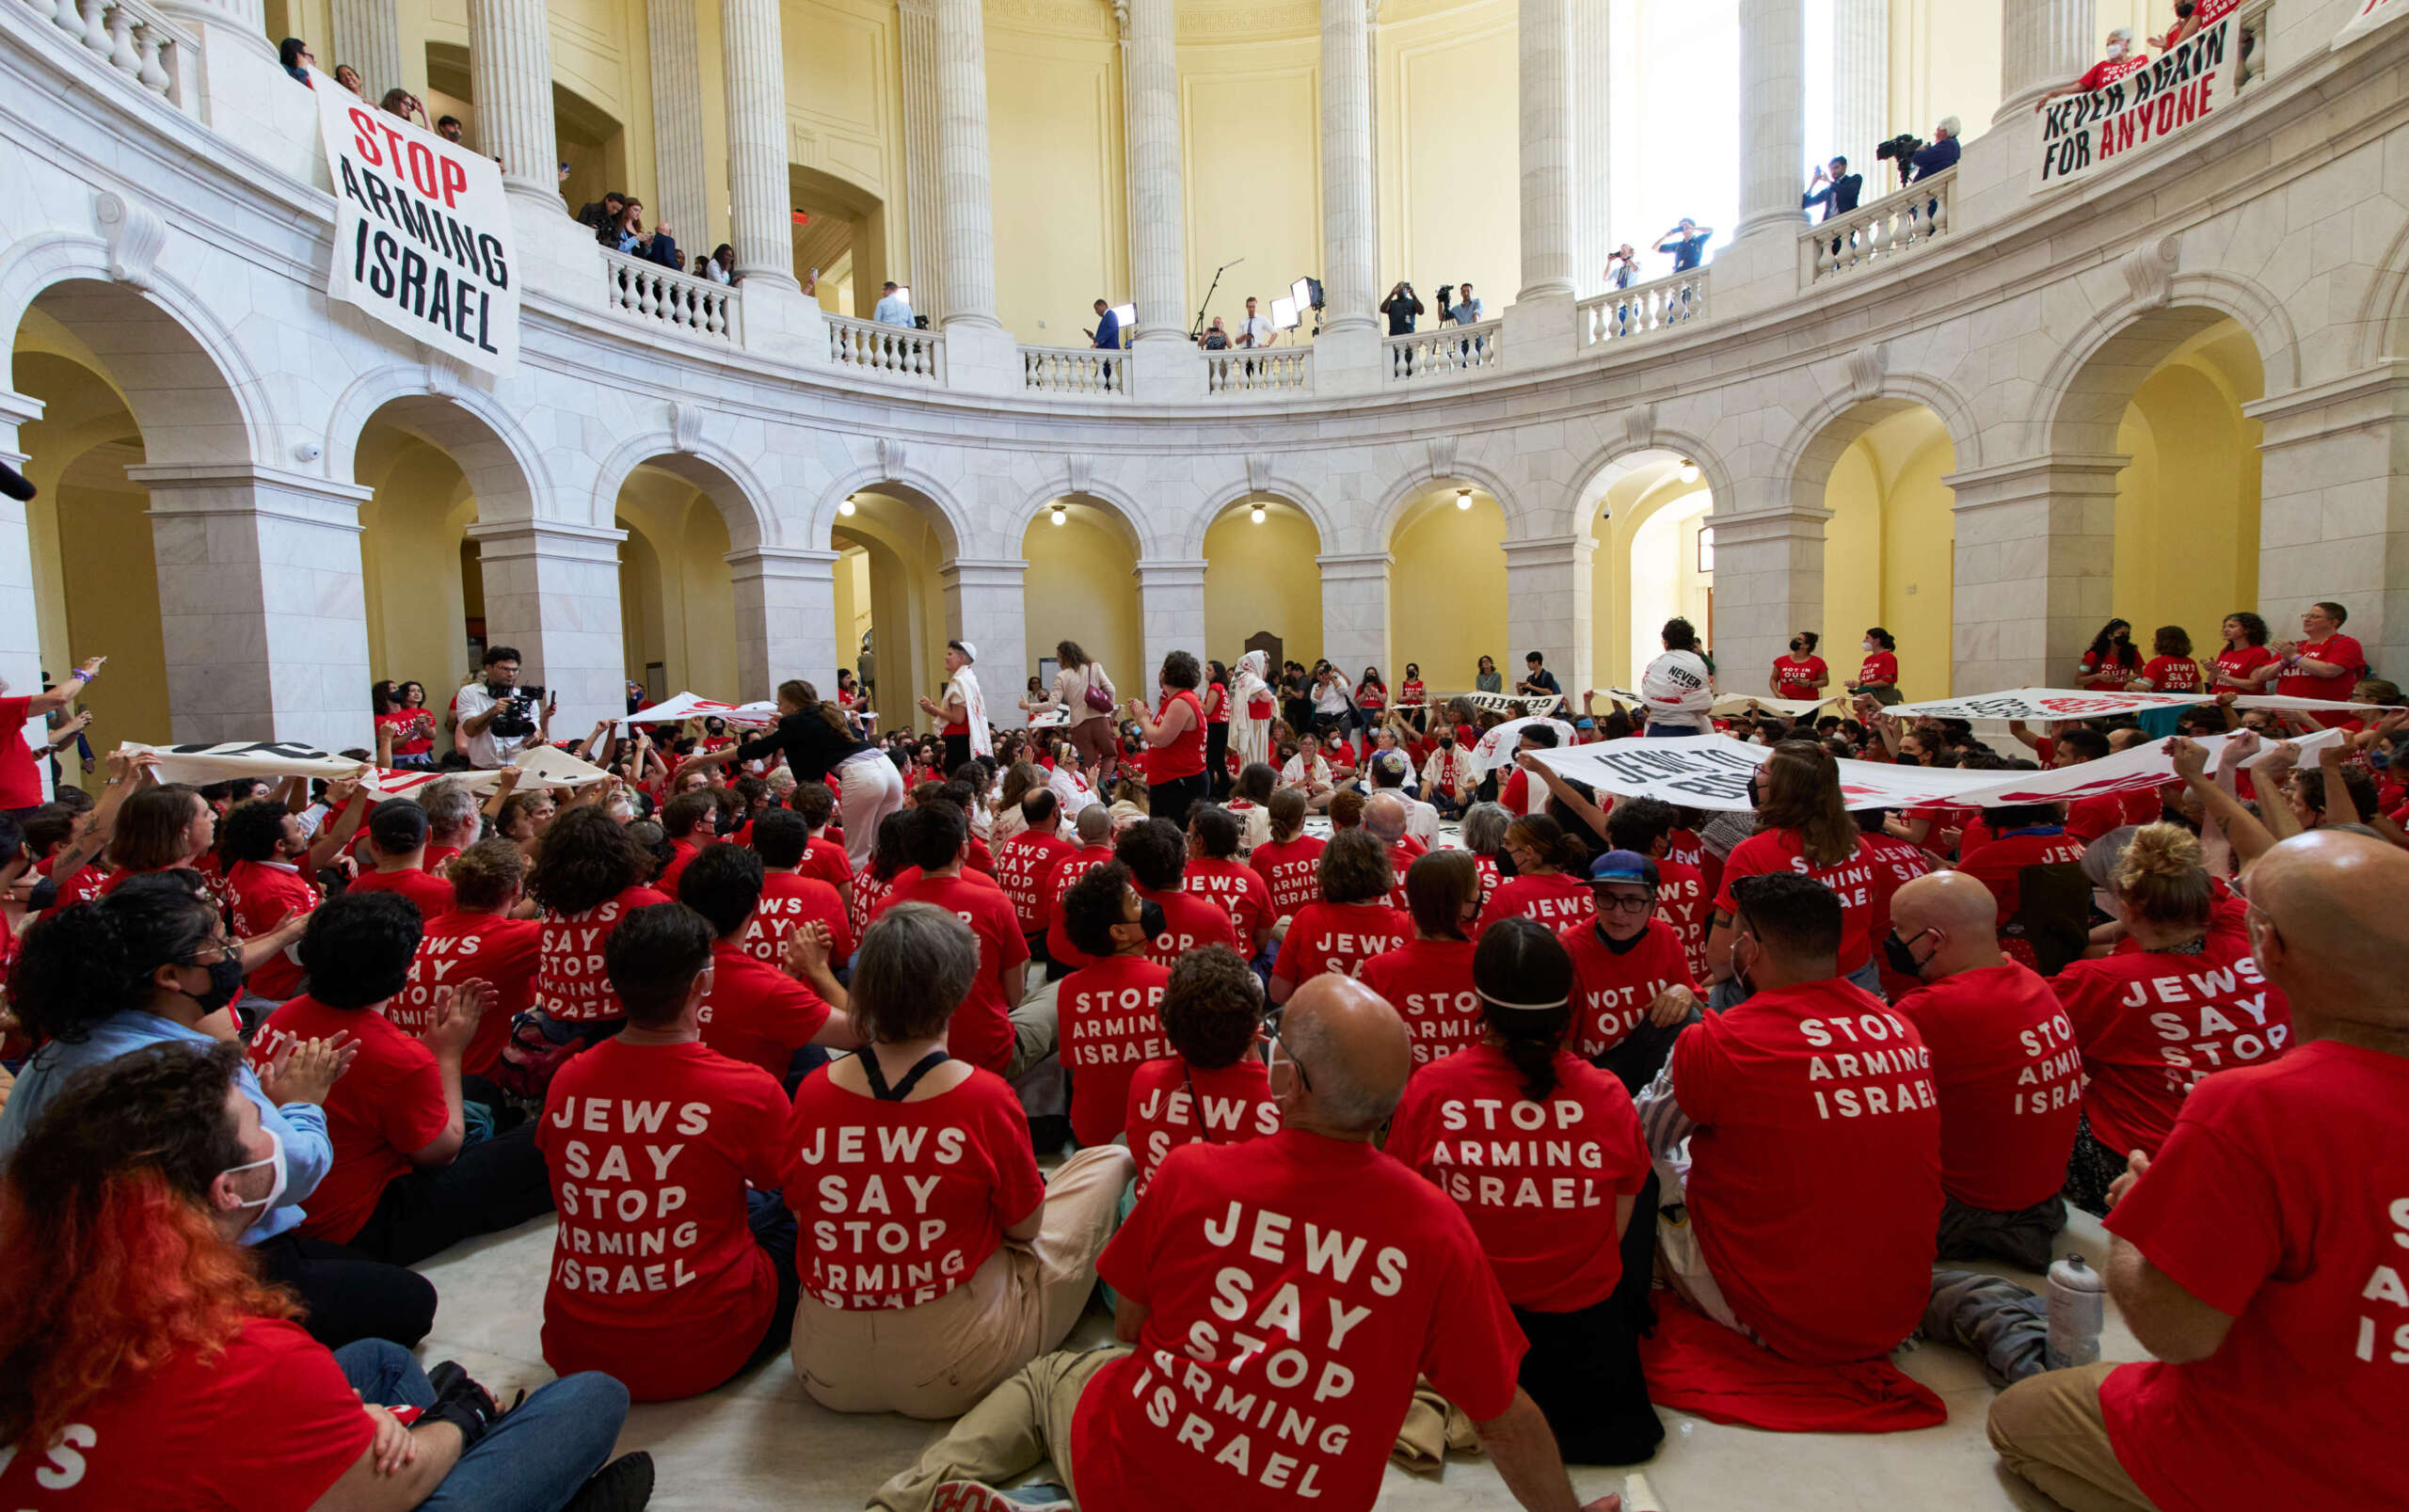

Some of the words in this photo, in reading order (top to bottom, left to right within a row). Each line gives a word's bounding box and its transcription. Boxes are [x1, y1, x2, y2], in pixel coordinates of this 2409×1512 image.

[2043, 83, 2126, 141] NEVER
[2132, 20, 2227, 105] AGAIN
[2042, 130, 2090, 181] FOR
[2099, 72, 2215, 160] ANYONE
[348, 107, 468, 210] STOP
[340, 152, 508, 291] ARMING
[355, 217, 498, 355] ISRAEL
[1667, 665, 1701, 689] NEVER
[2168, 673, 2194, 681] SAY
[1593, 750, 1720, 784] JEWS
[1005, 841, 1049, 860] EWS
[1274, 875, 1318, 893] ARMIN
[1274, 887, 1322, 906] ISRAE
[1204, 895, 1240, 912] AY
[1523, 896, 1595, 919] JEWS
[1656, 902, 1695, 924] AY
[541, 928, 599, 953] SAY
[746, 918, 790, 939] AY
[1316, 932, 1404, 954] JEWS
[407, 960, 458, 982] AY
[540, 953, 605, 976] STOP
[2122, 957, 2266, 1007] JEWS
[1407, 991, 1477, 1015] STO
[2149, 992, 2267, 1041] SAY
[1073, 1014, 1164, 1039] ARMIN
[1598, 1008, 1644, 1035] OU
[1799, 1013, 1905, 1047] STOP
[2019, 1014, 2070, 1057] STO
[1809, 1046, 1929, 1081] ARMING
[2161, 1024, 2288, 1068] STOP
[552, 1096, 711, 1136] JEWS
[1140, 1089, 1281, 1135] JEWS
[1442, 1099, 1585, 1131] STOP
[565, 1140, 685, 1182] SAY
[802, 1126, 966, 1165] JEWS
[1432, 1140, 1602, 1169] ARMING
[563, 1182, 687, 1222] STOP
[818, 1174, 942, 1215] SAY
[814, 1219, 947, 1254] STOP
[1204, 1201, 1408, 1297] JEWS
[555, 1258, 696, 1294] ISRAEL
[813, 1249, 965, 1292] ARMING
[1210, 1267, 1372, 1351] SAY
[1184, 1320, 1354, 1403] STOP
[1154, 1349, 1351, 1455] ARMING
[1132, 1367, 1322, 1498] ISRAEL
